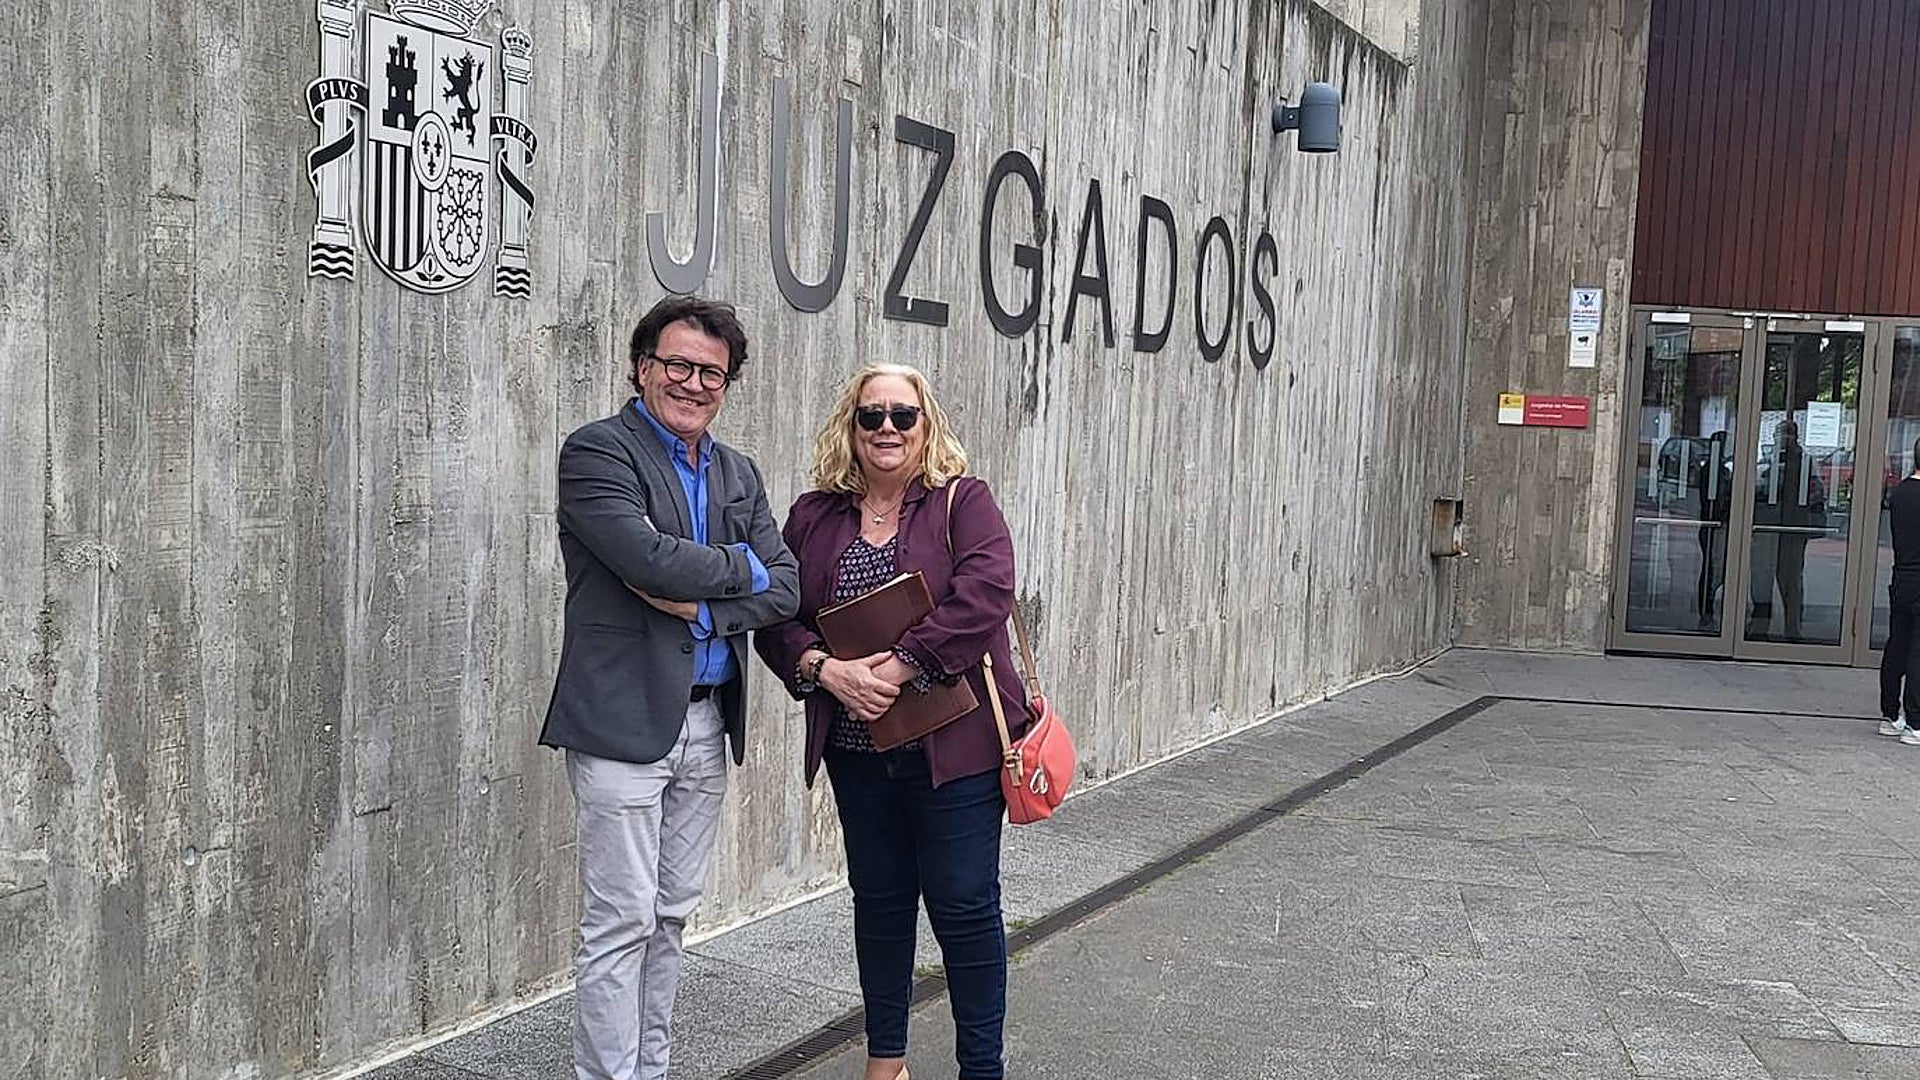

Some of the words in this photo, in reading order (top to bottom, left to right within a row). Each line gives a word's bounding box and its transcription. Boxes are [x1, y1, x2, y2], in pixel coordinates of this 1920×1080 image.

[318, 80, 359, 100] PLVS
[495, 118, 534, 149] VLTRA
[646, 52, 1279, 370] JUZGADOS
